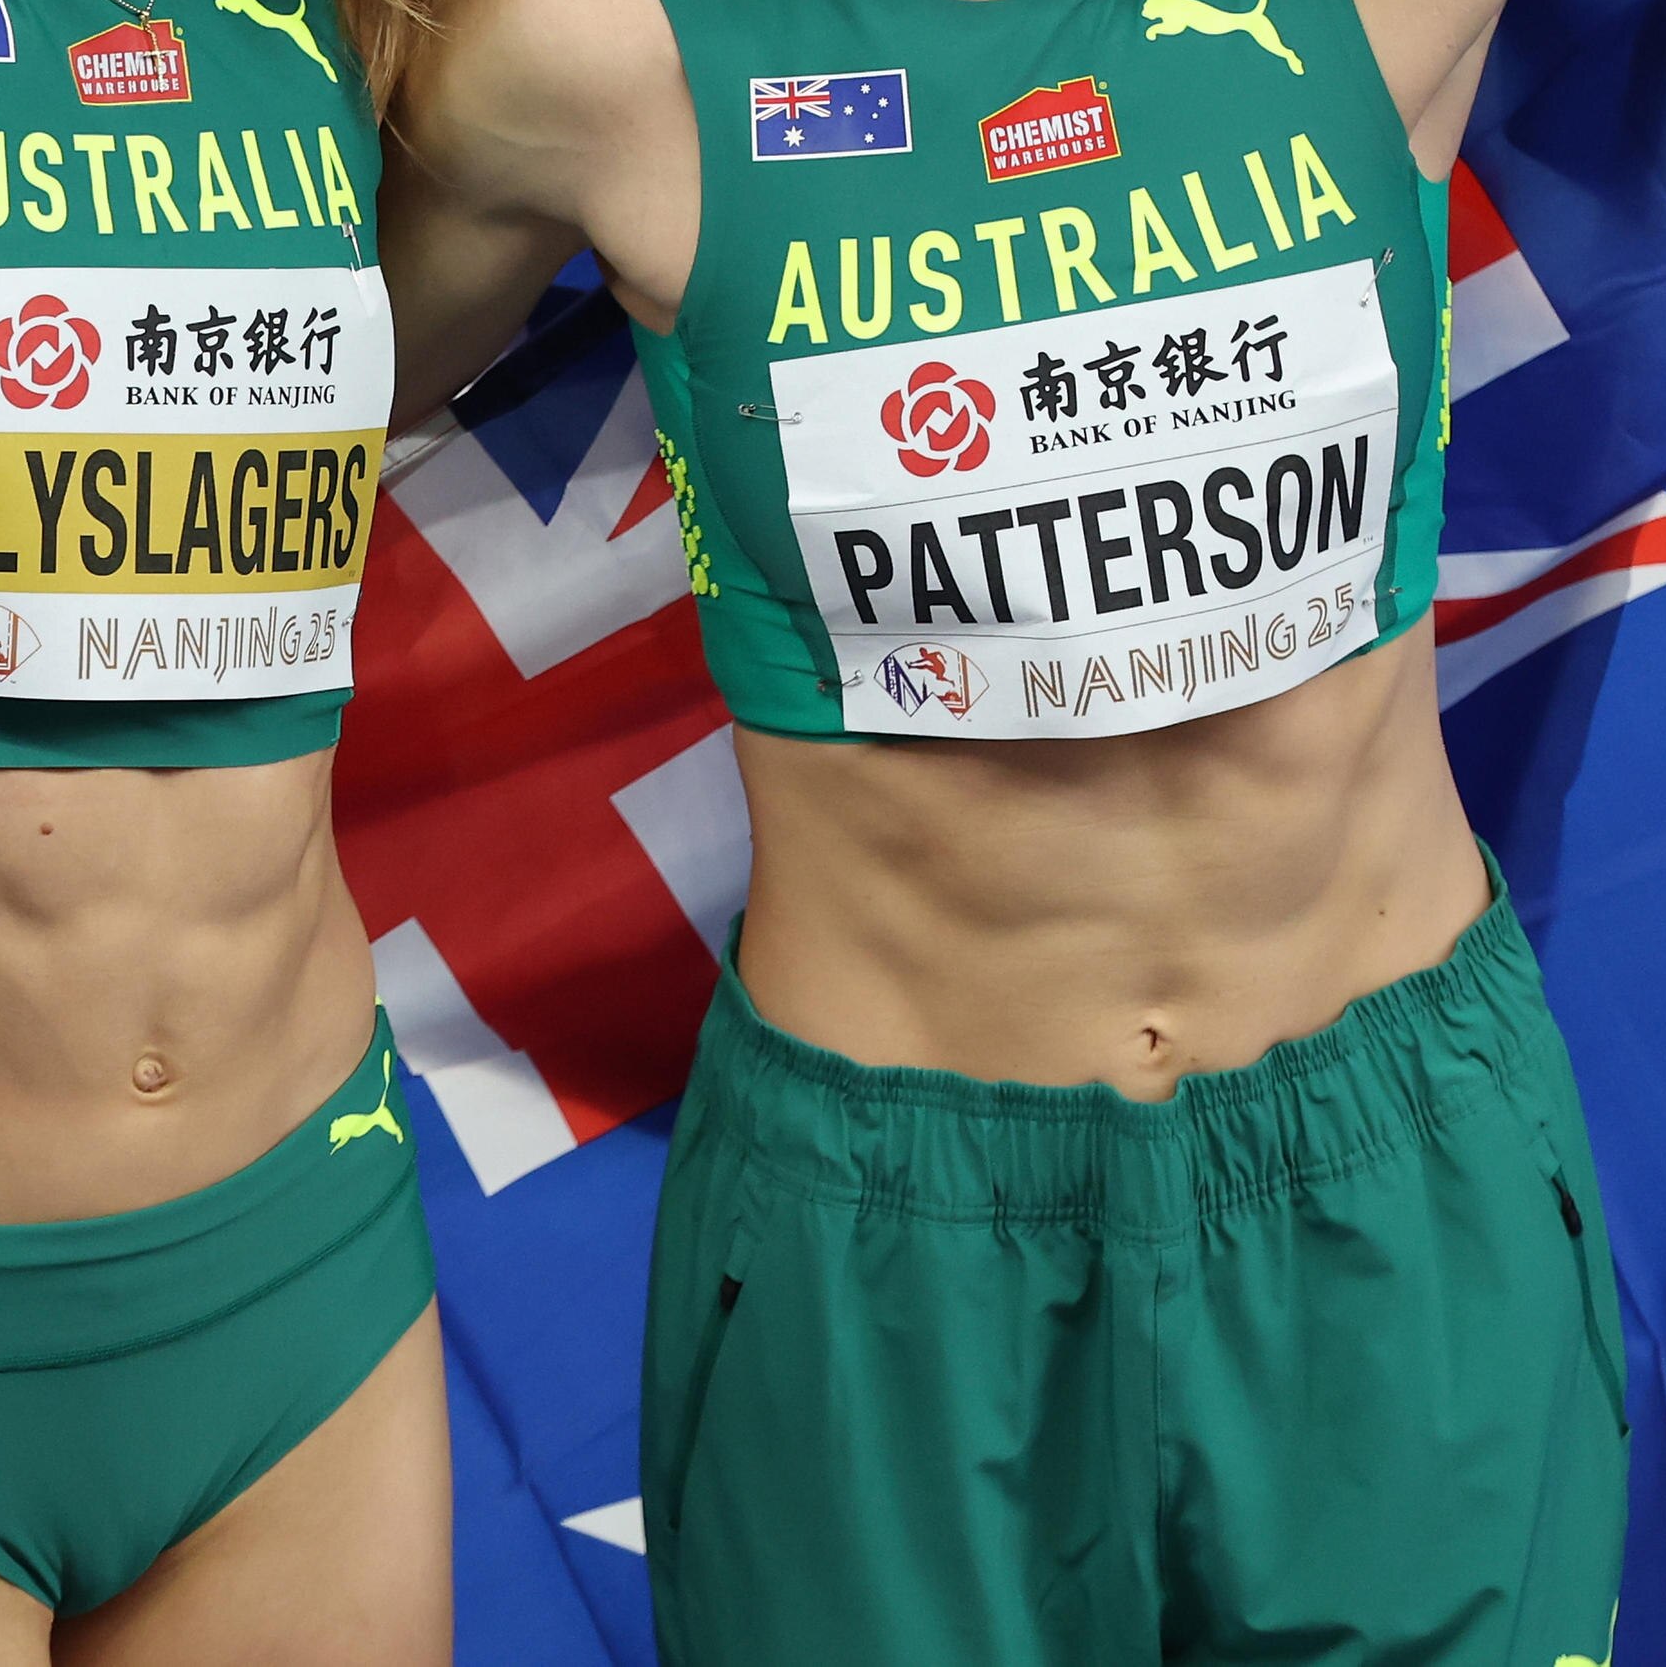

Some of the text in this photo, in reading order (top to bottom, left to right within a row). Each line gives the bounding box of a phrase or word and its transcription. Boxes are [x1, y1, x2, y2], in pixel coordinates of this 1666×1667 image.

[81, 77, 180, 95] WAREHOUSE
[989, 106, 1103, 153] CHEMIST
[994, 135, 1106, 170] WAREHOUSE
[767, 133, 1357, 345] AUSTRALIA
[126, 303, 341, 377] 南京银行
[1019, 314, 1288, 422] 南京银行
[126, 384, 336, 409] BANK OF NANJING
[1029, 389, 1297, 454] BANK OF NANJING
[834, 434, 1369, 625] PATTERSON
